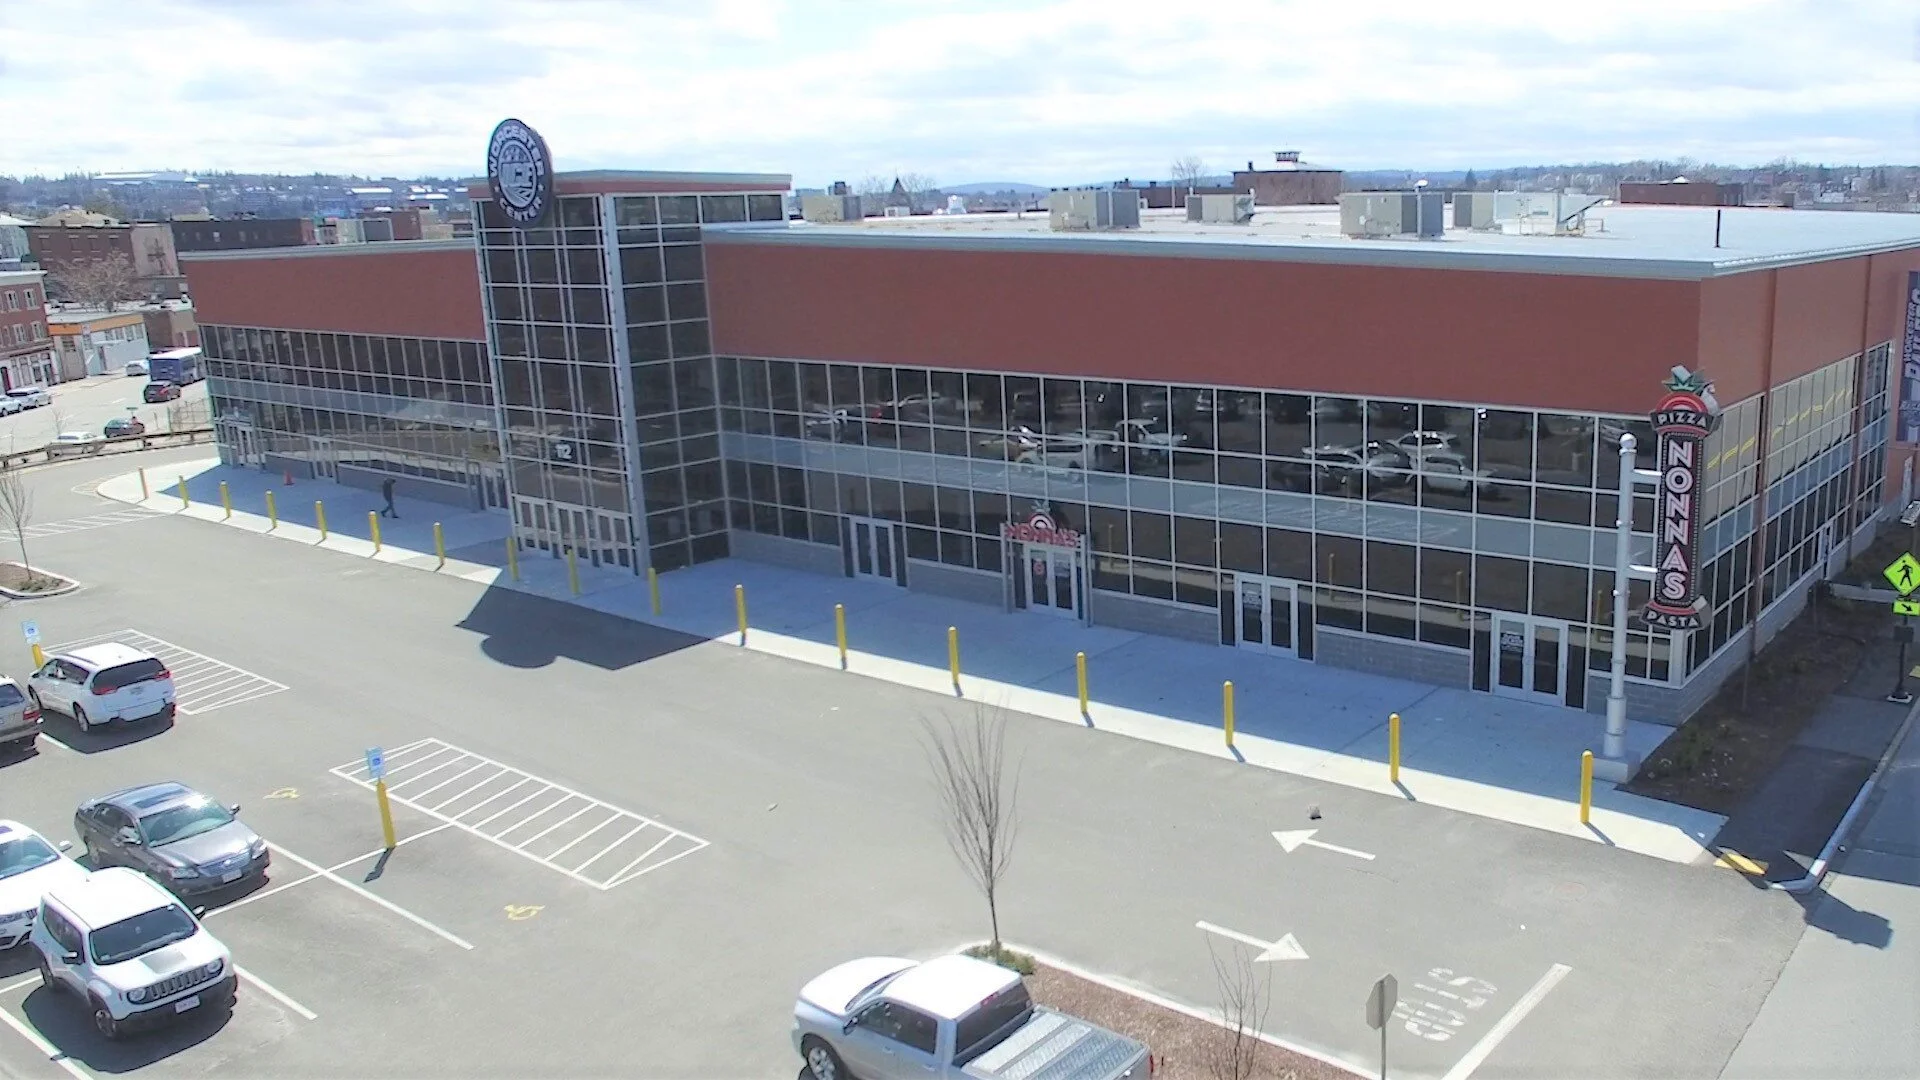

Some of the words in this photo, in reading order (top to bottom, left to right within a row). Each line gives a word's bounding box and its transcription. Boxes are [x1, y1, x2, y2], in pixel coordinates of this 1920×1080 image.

[489, 125, 545, 178] WORCESTER
[499, 197, 543, 221] CENTER
[1657, 411, 1707, 428] PIZZA
[555, 443, 572, 459] 12
[1661, 440, 1693, 600] NONNAS
[1646, 610, 1698, 627] PASTA
